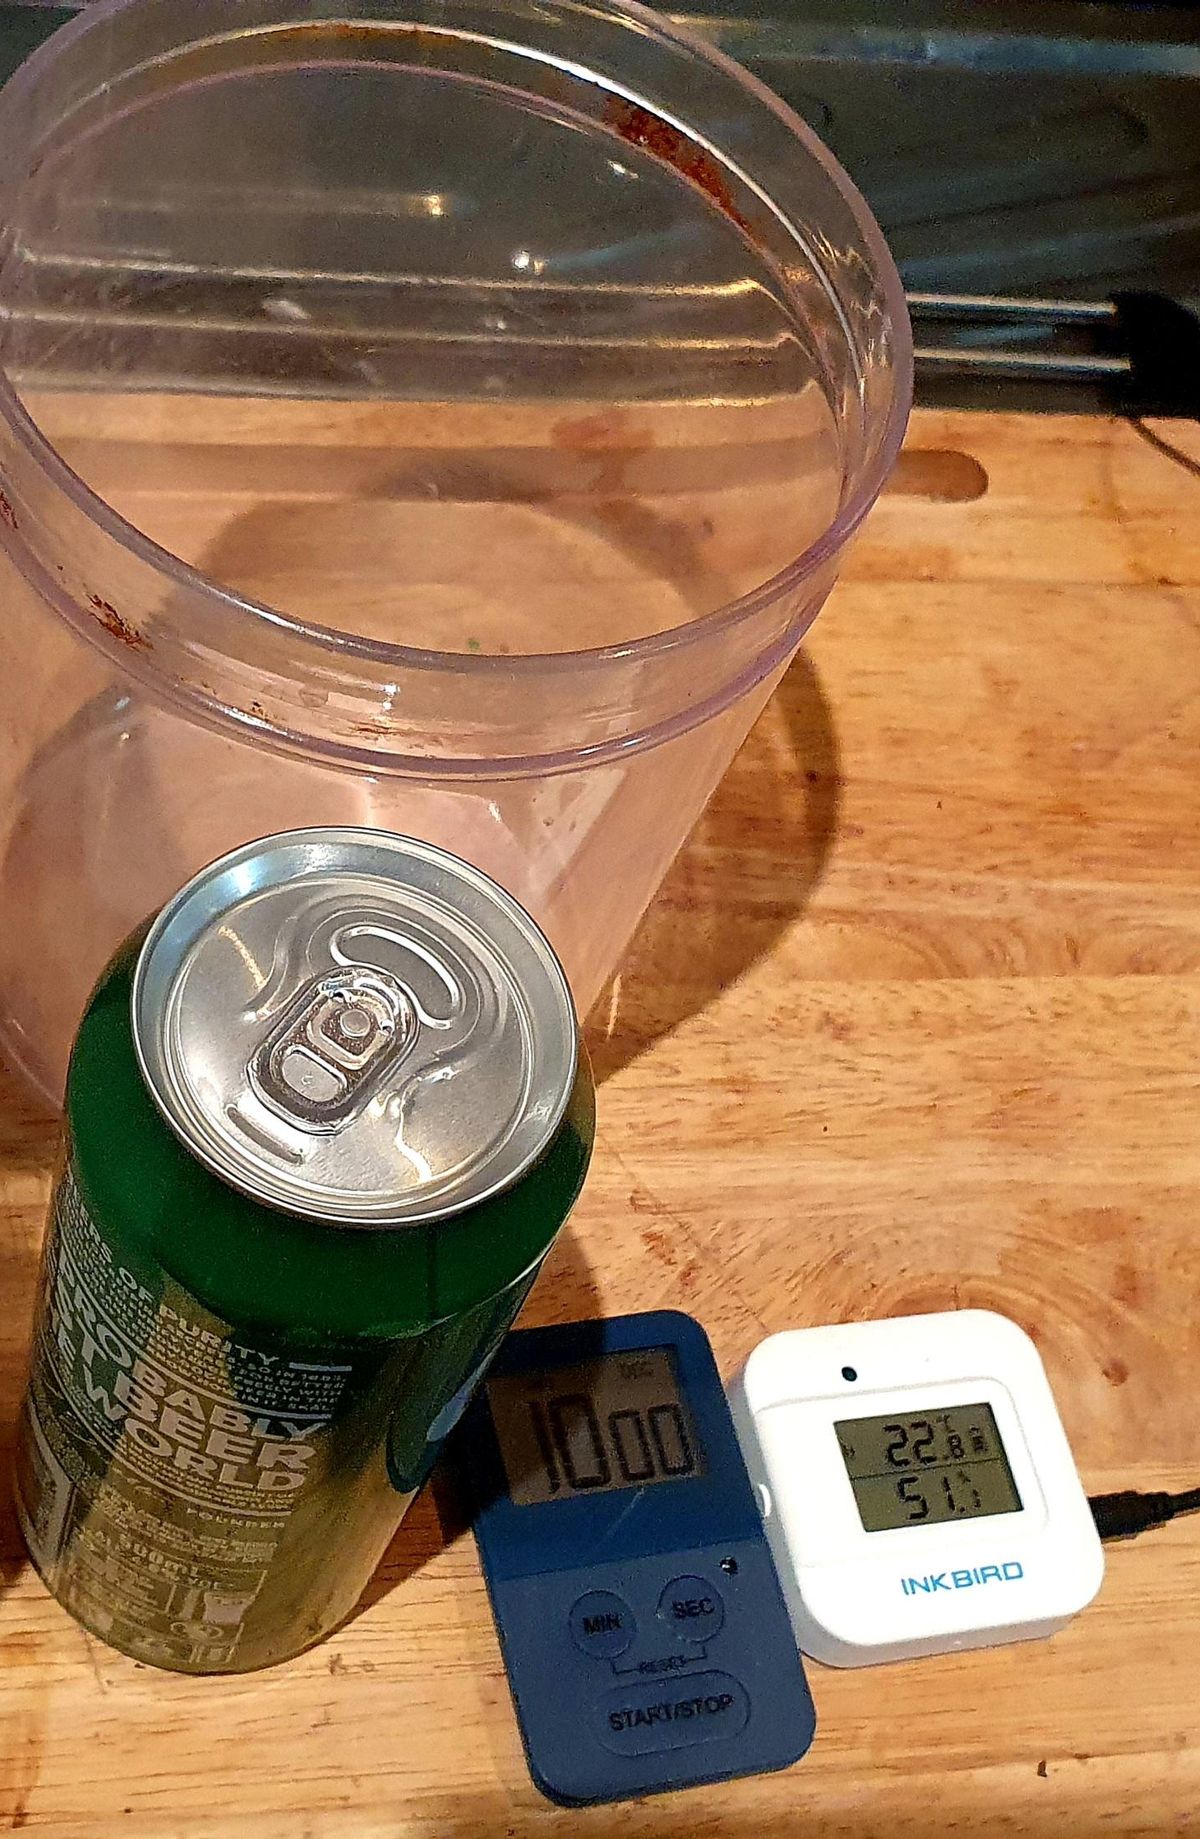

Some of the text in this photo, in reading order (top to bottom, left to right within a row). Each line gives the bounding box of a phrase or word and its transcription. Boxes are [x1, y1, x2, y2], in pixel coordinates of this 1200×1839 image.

[57, 1246, 327, 1442] PROBABLY
[118, 1266, 155, 1302] OF
[160, 1303, 279, 1366] PURITY
[81, 1361, 307, 1491] WORLD
[113, 1370, 316, 1471] BEER
[672, 1598, 715, 1619] SEC
[900, 1561, 1024, 1596] INKBIRD
[582, 1613, 622, 1636] MIN
[608, 1693, 735, 1732] START/STOP
